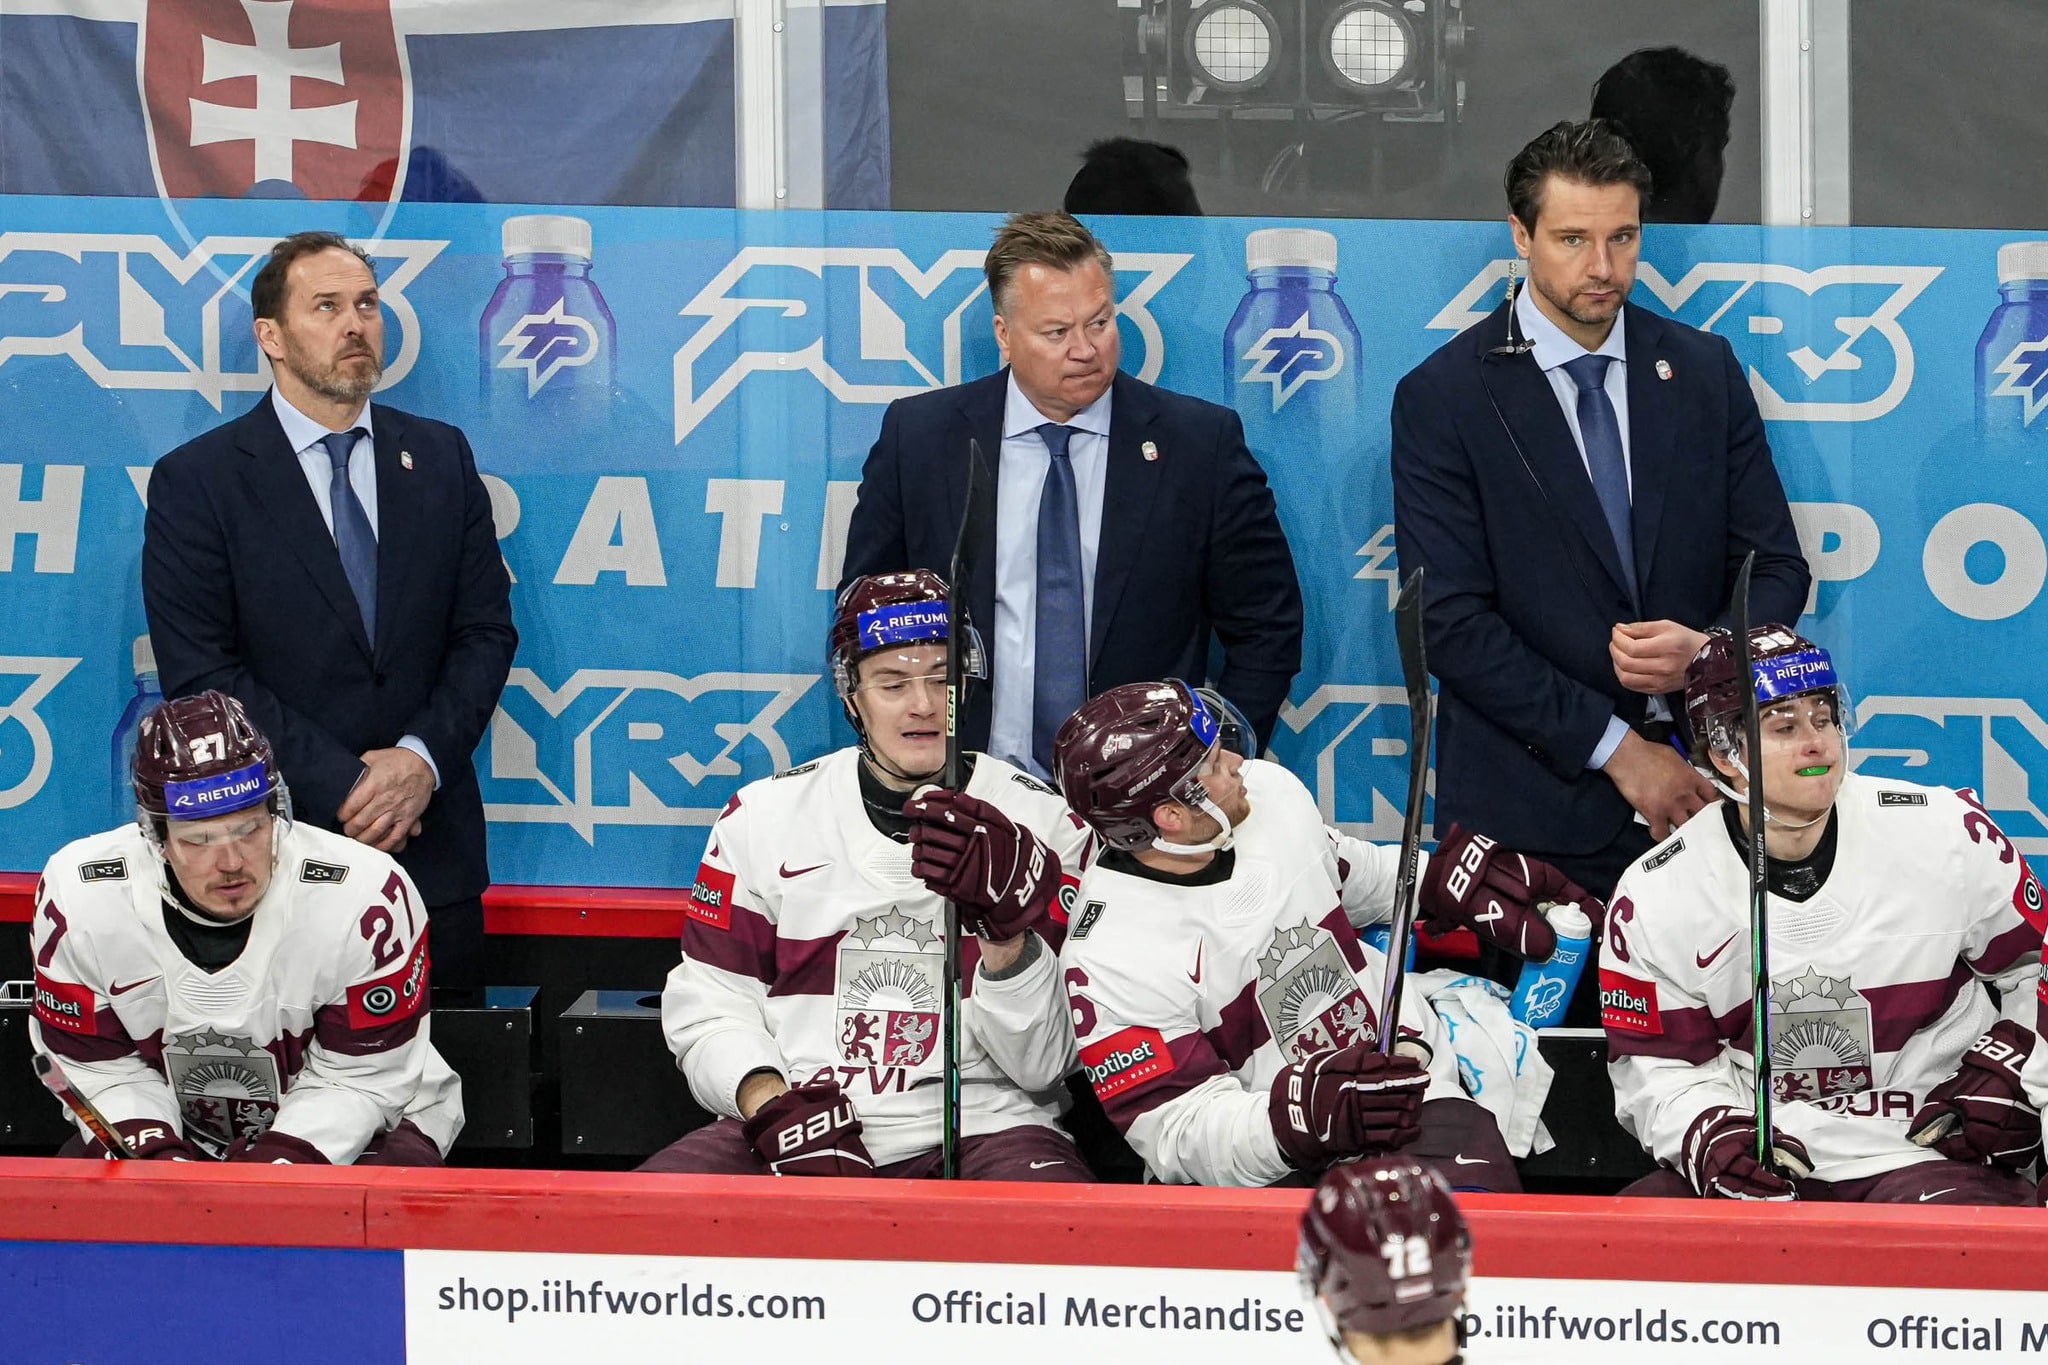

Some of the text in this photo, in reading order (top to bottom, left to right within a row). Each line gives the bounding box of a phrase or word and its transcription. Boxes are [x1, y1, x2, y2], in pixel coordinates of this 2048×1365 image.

[1776, 661, 1829, 680] RIETUMU
[946, 690, 954, 732] CCM
[189, 732, 226, 764] 27
[197, 778, 260, 803] RIETUMU
[1757, 833, 1765, 874] BAUER
[360, 870, 415, 971] 27
[1601, 988, 1649, 1013] ptibet
[1380, 1235, 1433, 1280] 72
[438, 1277, 826, 1323] shop.iihfworlds.com
[912, 1291, 1305, 1333] Official Merchandise
[1462, 1305, 1780, 1346] p.iihfworlds.com
[1867, 1315, 2002, 1351] Official
